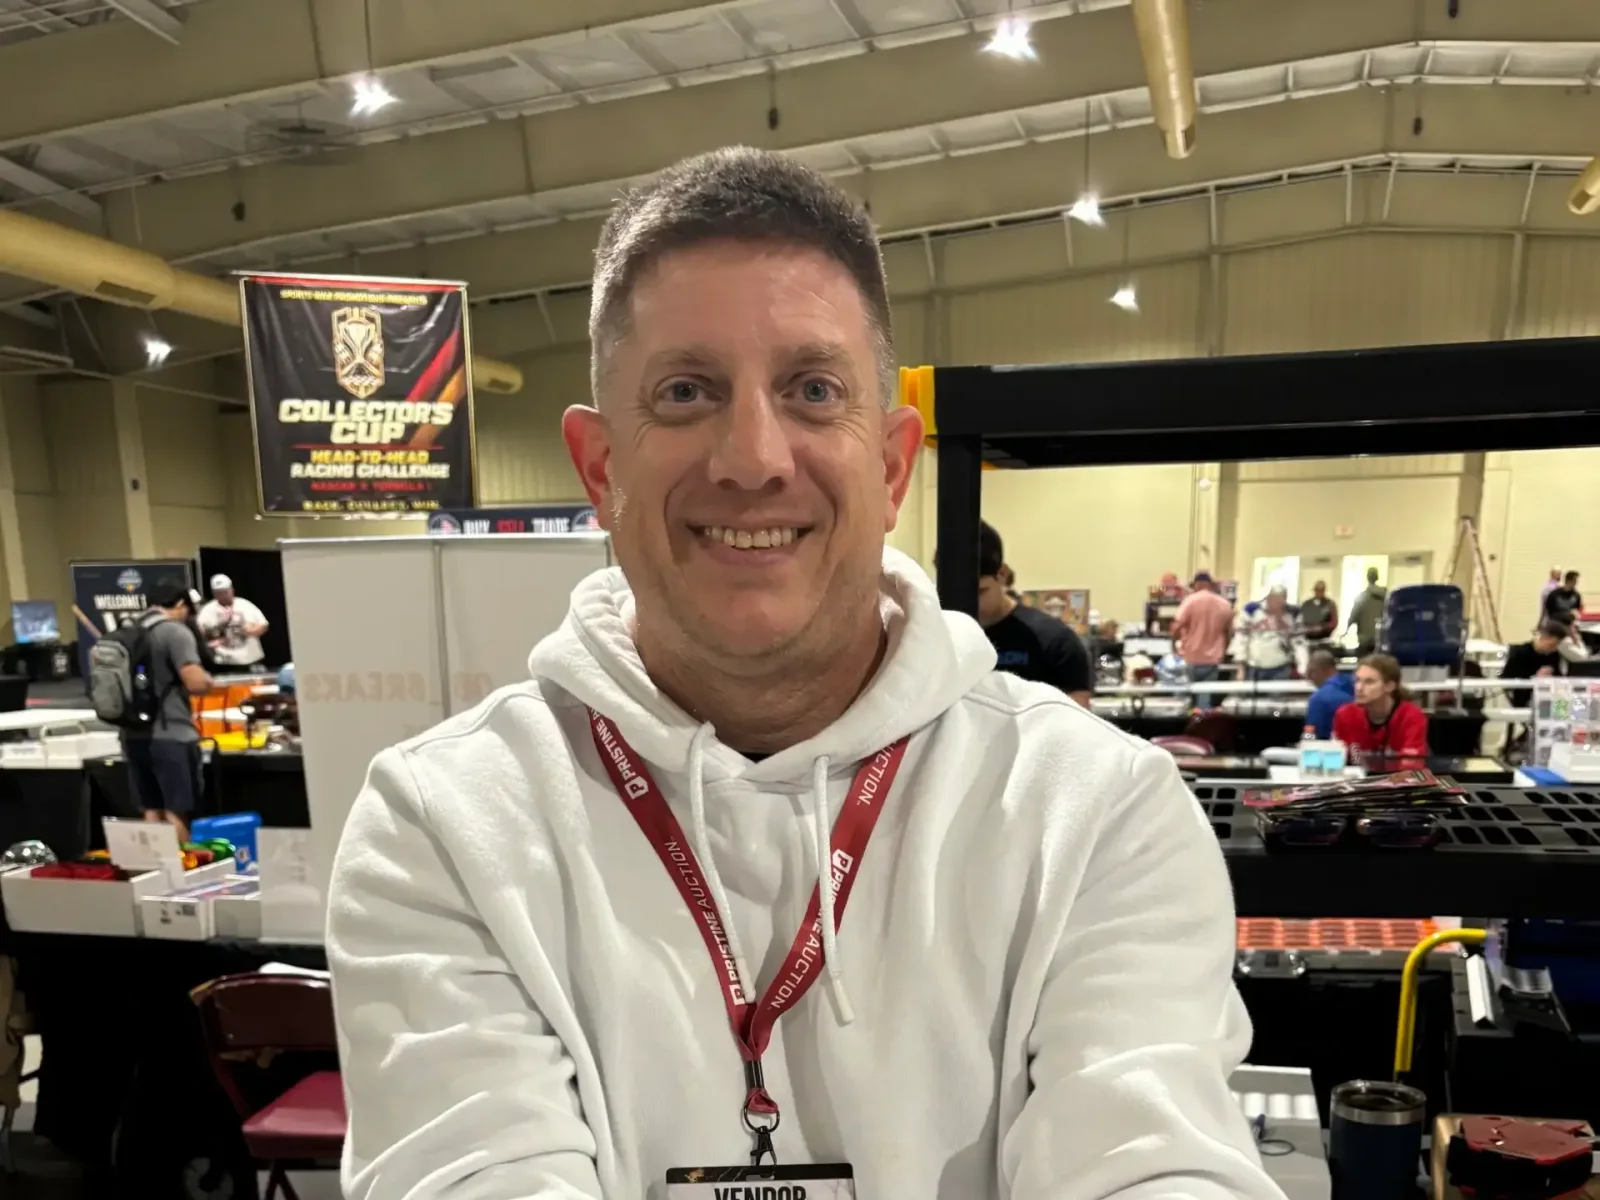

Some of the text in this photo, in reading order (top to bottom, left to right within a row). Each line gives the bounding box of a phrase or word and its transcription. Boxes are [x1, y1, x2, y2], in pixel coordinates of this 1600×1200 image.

[330, 421, 405, 444] CUP
[311, 450, 430, 464] HEAD-TO-HEAD
[290, 463, 450, 479] RACING CHALLENGE
[463, 519, 490, 534] BUY
[531, 517, 570, 533] TRADE
[94, 594, 140, 610] WELCOME
[596, 719, 637, 781] PRISTINE
[665, 841, 712, 909] AUCTION
[771, 934, 820, 1009] AUCTION
[714, 1185, 807, 1200] VENDOR
